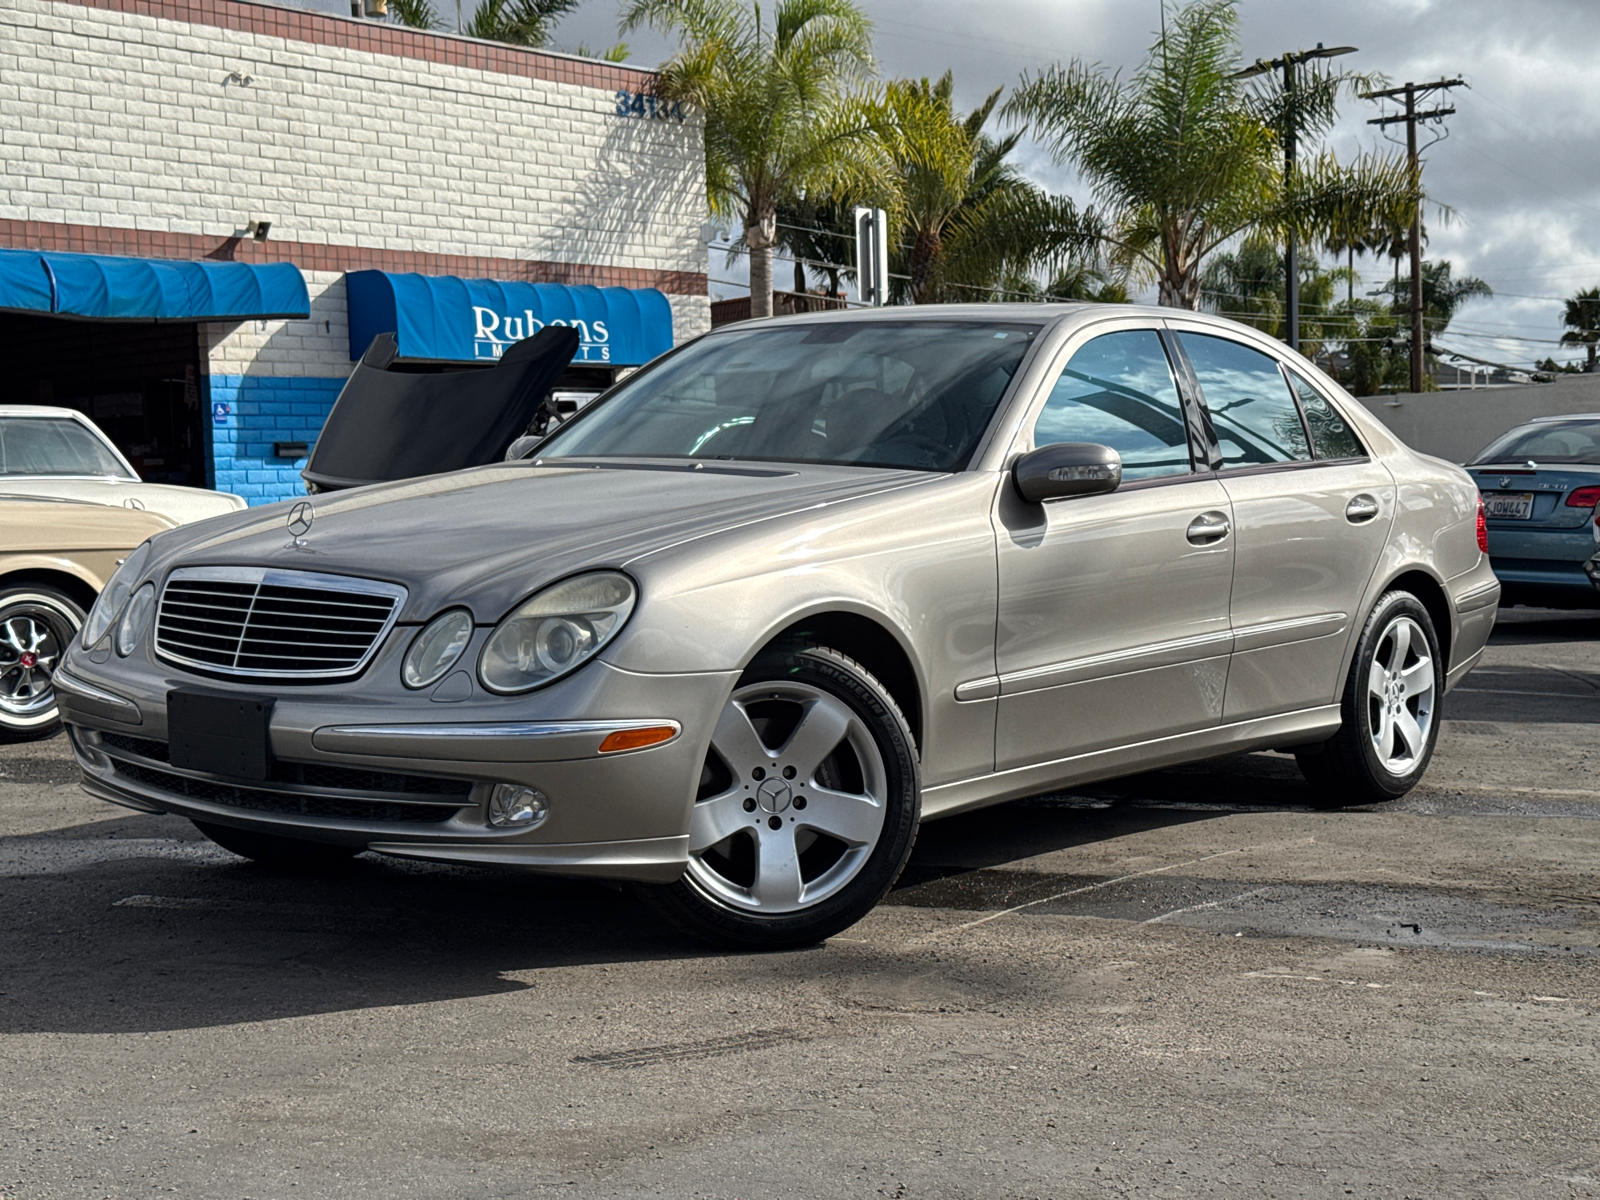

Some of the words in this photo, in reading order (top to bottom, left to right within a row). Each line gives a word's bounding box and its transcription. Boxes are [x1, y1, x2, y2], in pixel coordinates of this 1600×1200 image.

[472, 306, 609, 343] Rubns
[474, 342, 610, 361] IMTS
[819, 664, 884, 715] MICHELIN
[888, 723, 902, 746] PILOT
